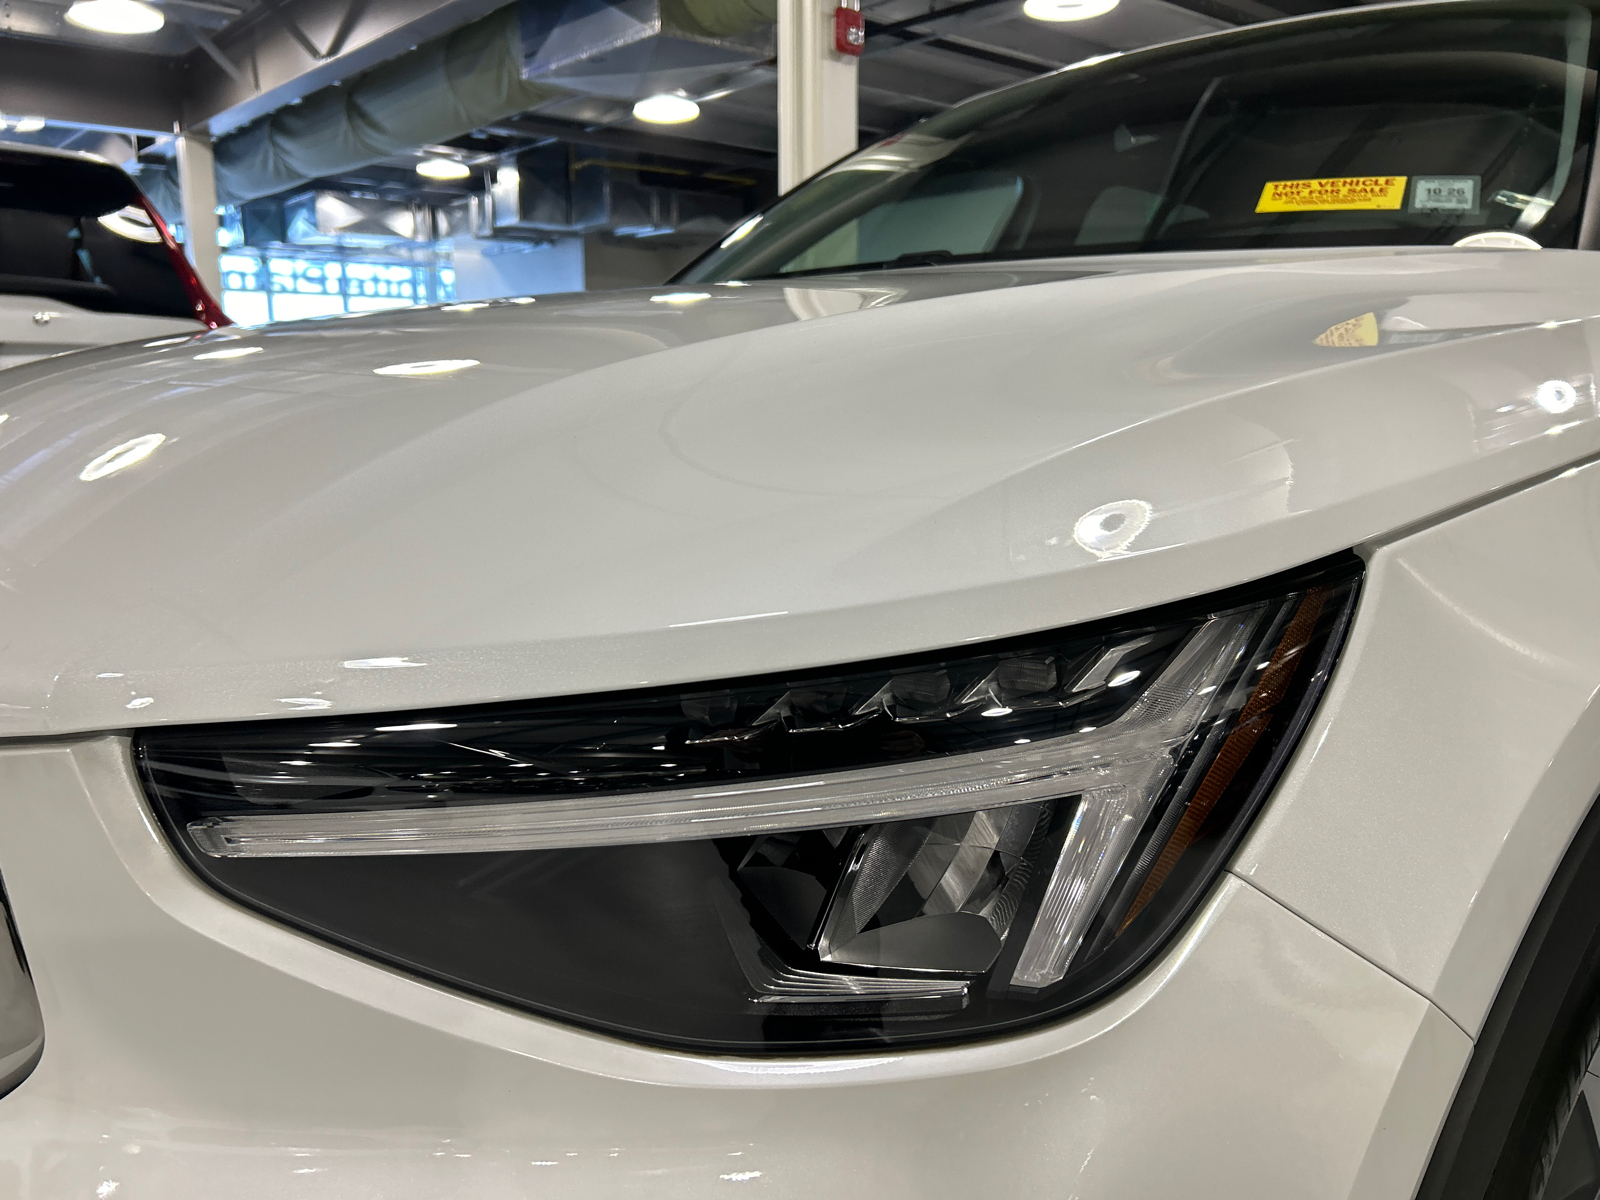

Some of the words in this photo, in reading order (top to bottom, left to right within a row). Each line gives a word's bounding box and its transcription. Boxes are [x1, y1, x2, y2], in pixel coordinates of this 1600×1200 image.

[1272, 181, 1312, 191] THIS
[1318, 178, 1397, 188] VEHICLE
[1271, 190, 1304, 198] NOT
[1308, 188, 1341, 196] FOR
[1347, 187, 1389, 195] SALE
[1425, 187, 1442, 195] 10
